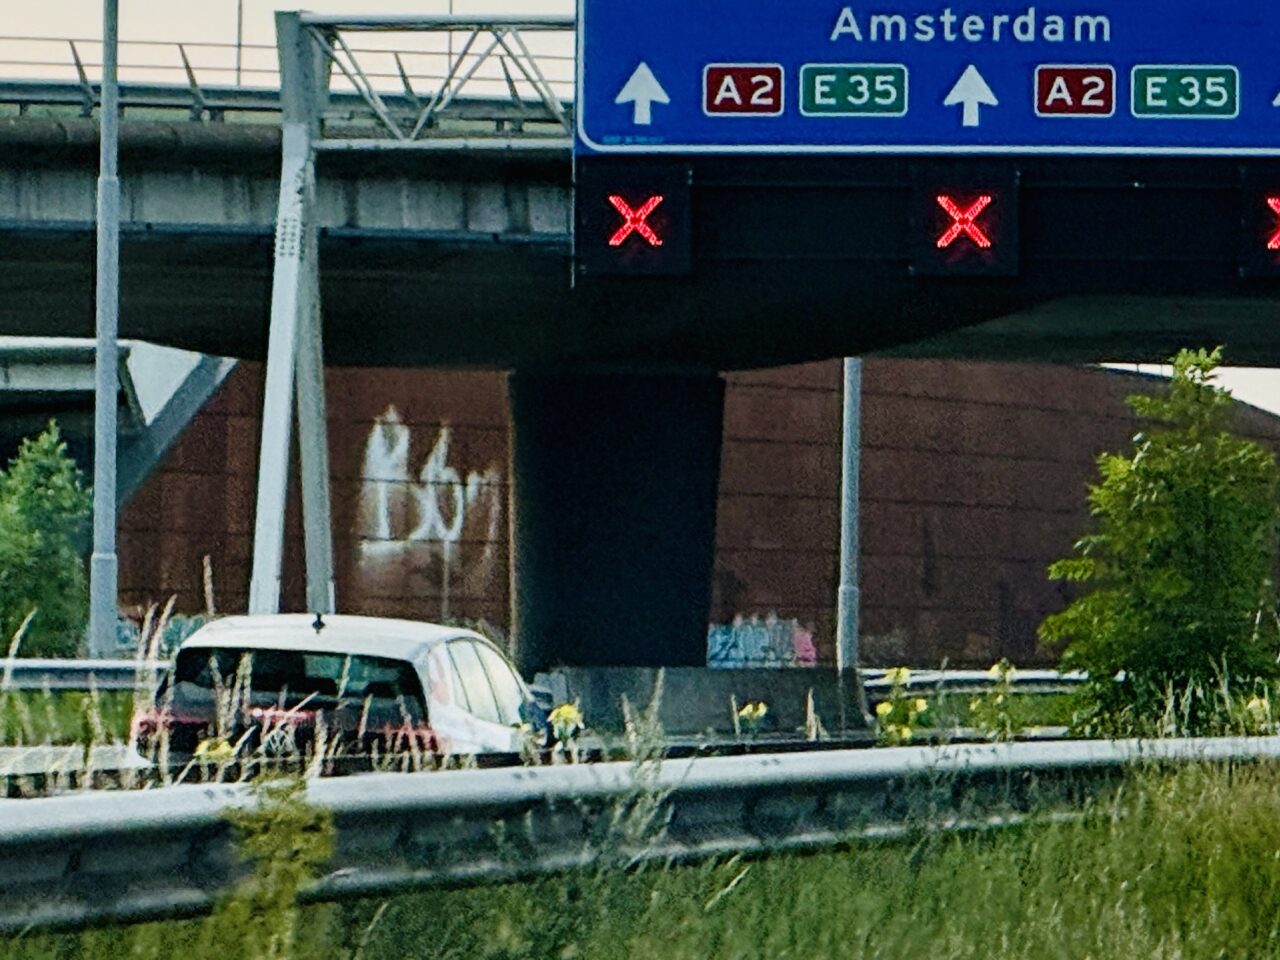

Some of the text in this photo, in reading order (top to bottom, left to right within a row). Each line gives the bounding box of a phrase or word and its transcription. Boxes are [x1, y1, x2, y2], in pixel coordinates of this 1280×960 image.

[829, 6, 1111, 43] Amsterdam
[713, 74, 775, 106] A2
[1044, 75, 1106, 107] A2
